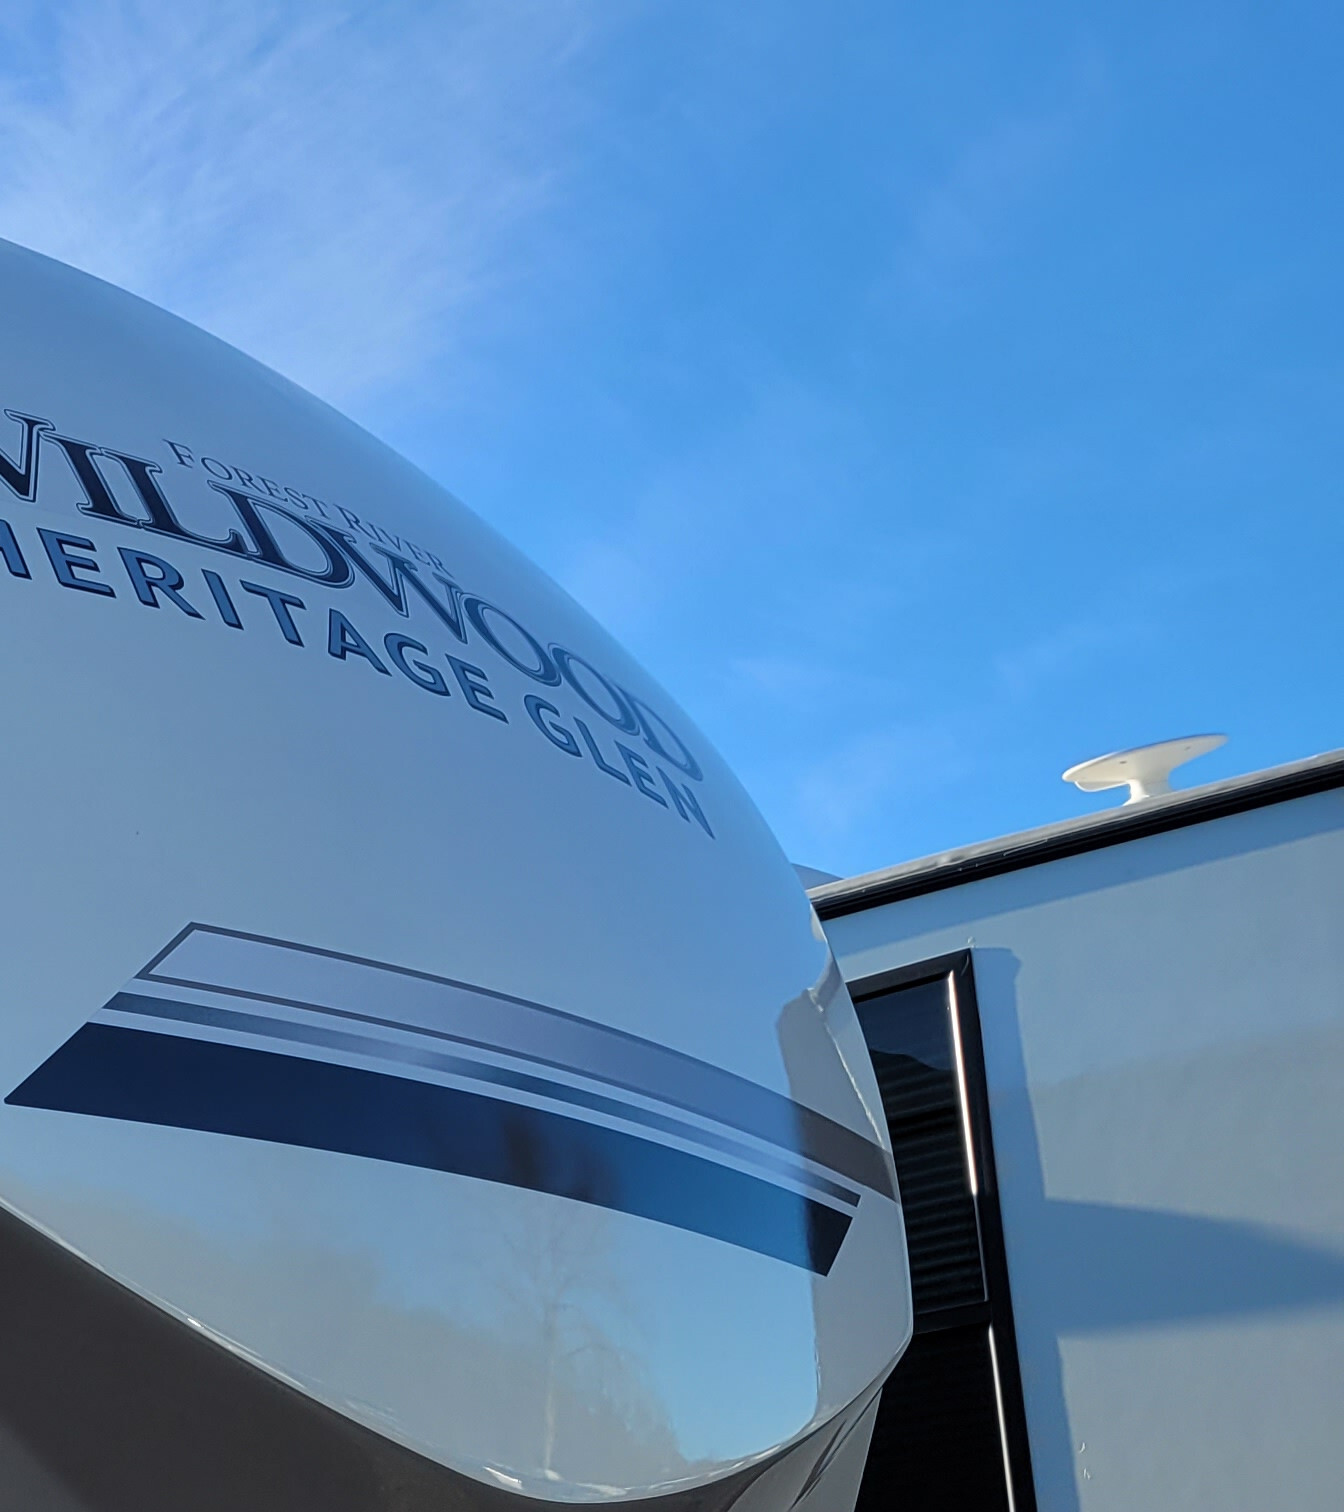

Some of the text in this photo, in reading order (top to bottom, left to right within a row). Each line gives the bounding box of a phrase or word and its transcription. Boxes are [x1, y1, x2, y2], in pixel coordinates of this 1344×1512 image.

[163, 438, 455, 580] FOREST RIVER
[523, 694, 716, 840] GLEN
